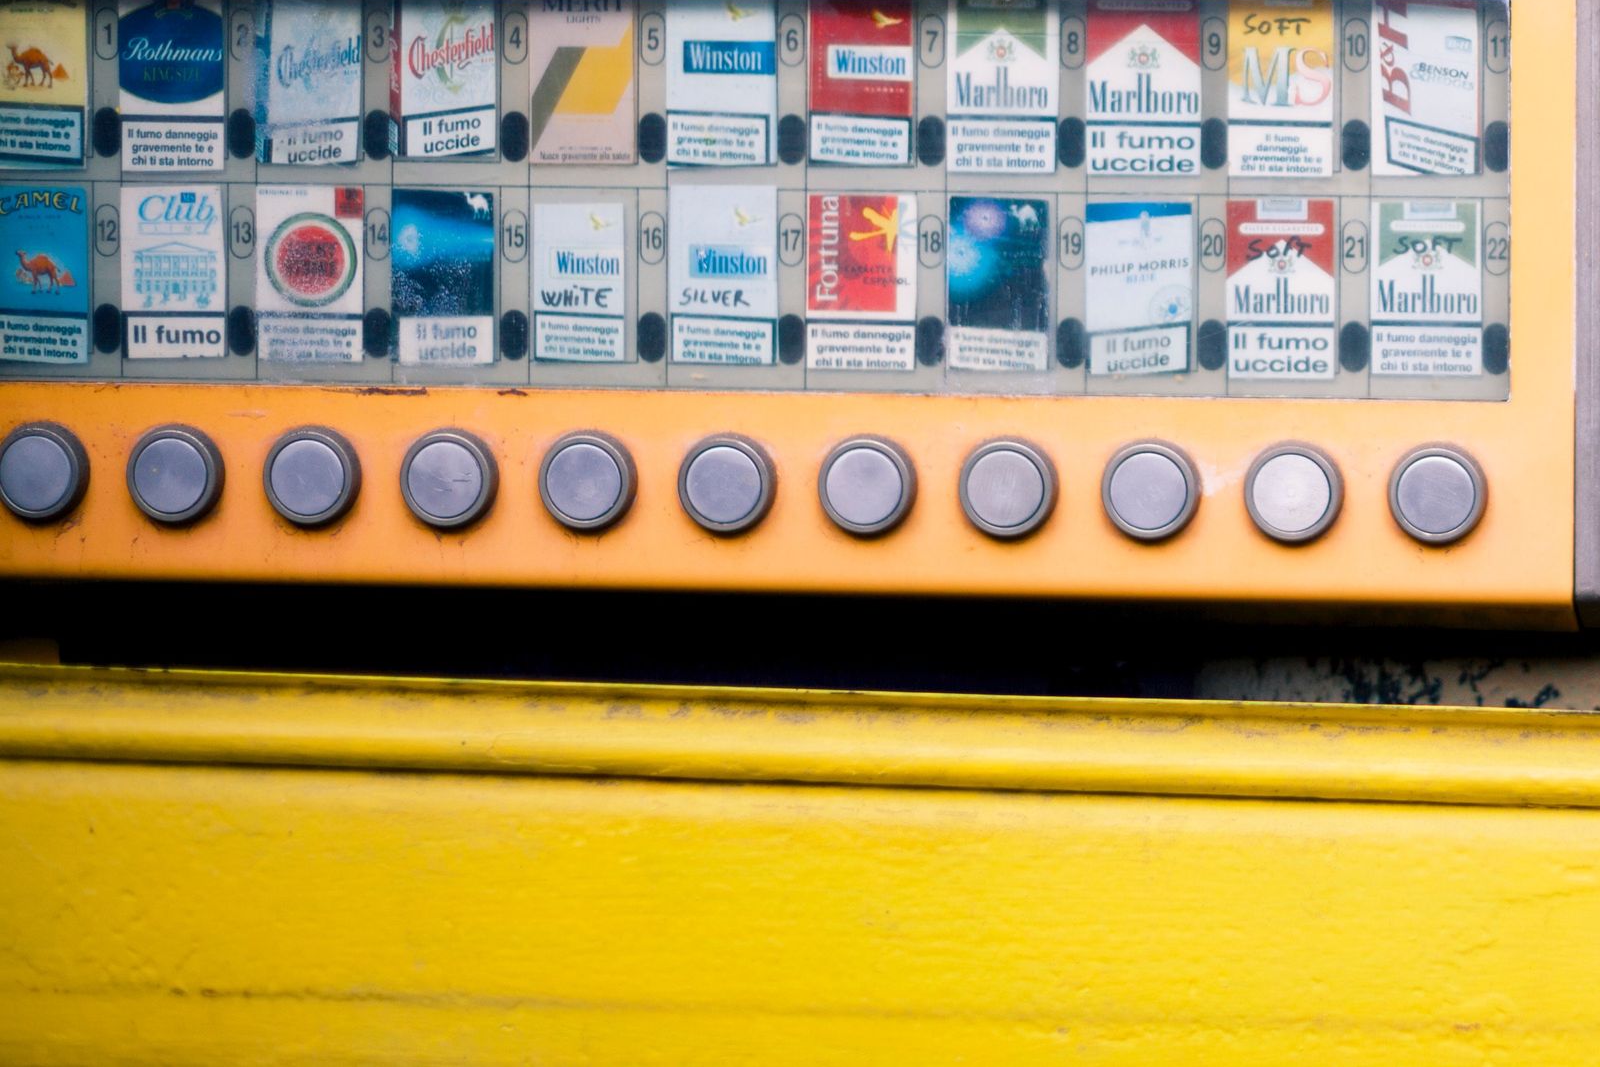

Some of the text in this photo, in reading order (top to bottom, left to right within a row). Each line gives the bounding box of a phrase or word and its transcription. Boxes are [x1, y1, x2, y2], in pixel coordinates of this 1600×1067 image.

[104, 23, 111, 45] 1
[373, 26, 384, 48] 3
[510, 26, 521, 48] 4
[648, 29, 659, 50] 5
[786, 29, 798, 51] 6
[926, 31, 938, 52] 7
[1067, 32, 1078, 54] 8
[1208, 33, 1220, 55] 9
[123, 37, 222, 61] Rothmans
[409, 22, 494, 79] Chesterfield
[1347, 35, 1366, 56] 10
[1491, 36, 1507, 58] 11
[690, 43, 761, 70] Winston
[836, 50, 906, 75] Winston
[1240, 46, 1332, 107] MS
[1419, 62, 1469, 79] BENSON
[955, 66, 1048, 108] Marlboro
[1089, 73, 1198, 114] Marlboro
[128, 129, 218, 141] Il fumo danneggia
[303, 129, 343, 144] fumo
[423, 118, 481, 135] Il fumo
[952, 126, 1050, 138] Il fumo danneggia
[132, 144, 191, 154] gravemente
[195, 144, 204, 152] te
[424, 135, 480, 153] uccide
[957, 142, 1044, 153] gravemente te e
[1092, 131, 1194, 150] Il fumo
[132, 155, 213, 166] chi ti sta intorno
[288, 145, 341, 163] uccide
[956, 157, 1045, 168] chi ti sta intorno
[1092, 155, 1194, 172] uccide
[0, 190, 84, 215] CAMEL
[138, 194, 217, 223] Club
[98, 220, 116, 241] 12
[233, 222, 252, 244] 13
[369, 224, 387, 246] 14
[506, 226, 524, 247] 15
[643, 227, 662, 249] 16
[782, 230, 800, 251] 17
[816, 195, 839, 302] Fortuna
[922, 232, 940, 252] 18
[1062, 233, 1081, 255] 19
[1203, 235, 1222, 256] 20
[1345, 236, 1364, 258] 21
[1488, 238, 1507, 260] 22
[557, 251, 619, 275] Winston
[696, 249, 767, 275] Winston
[1091, 258, 1189, 276] PHILIP MORRIS
[679, 288, 750, 307] SILVER
[1235, 278, 1329, 314] Marlboro
[1377, 275, 1477, 314] Marlboro
[134, 325, 221, 344] Il fumo
[433, 324, 476, 339] fumo
[1235, 333, 1328, 350] Il fumo
[1376, 333, 1477, 345] Il fumo danneggia
[419, 343, 476, 360] uccide
[1107, 336, 1171, 353] Il fumo
[1382, 348, 1448, 358] gravemente
[1452, 349, 1461, 357] te
[1108, 354, 1169, 372] uccide
[1235, 356, 1328, 373] uccide
[1380, 362, 1472, 372] chi ti sta intorno
